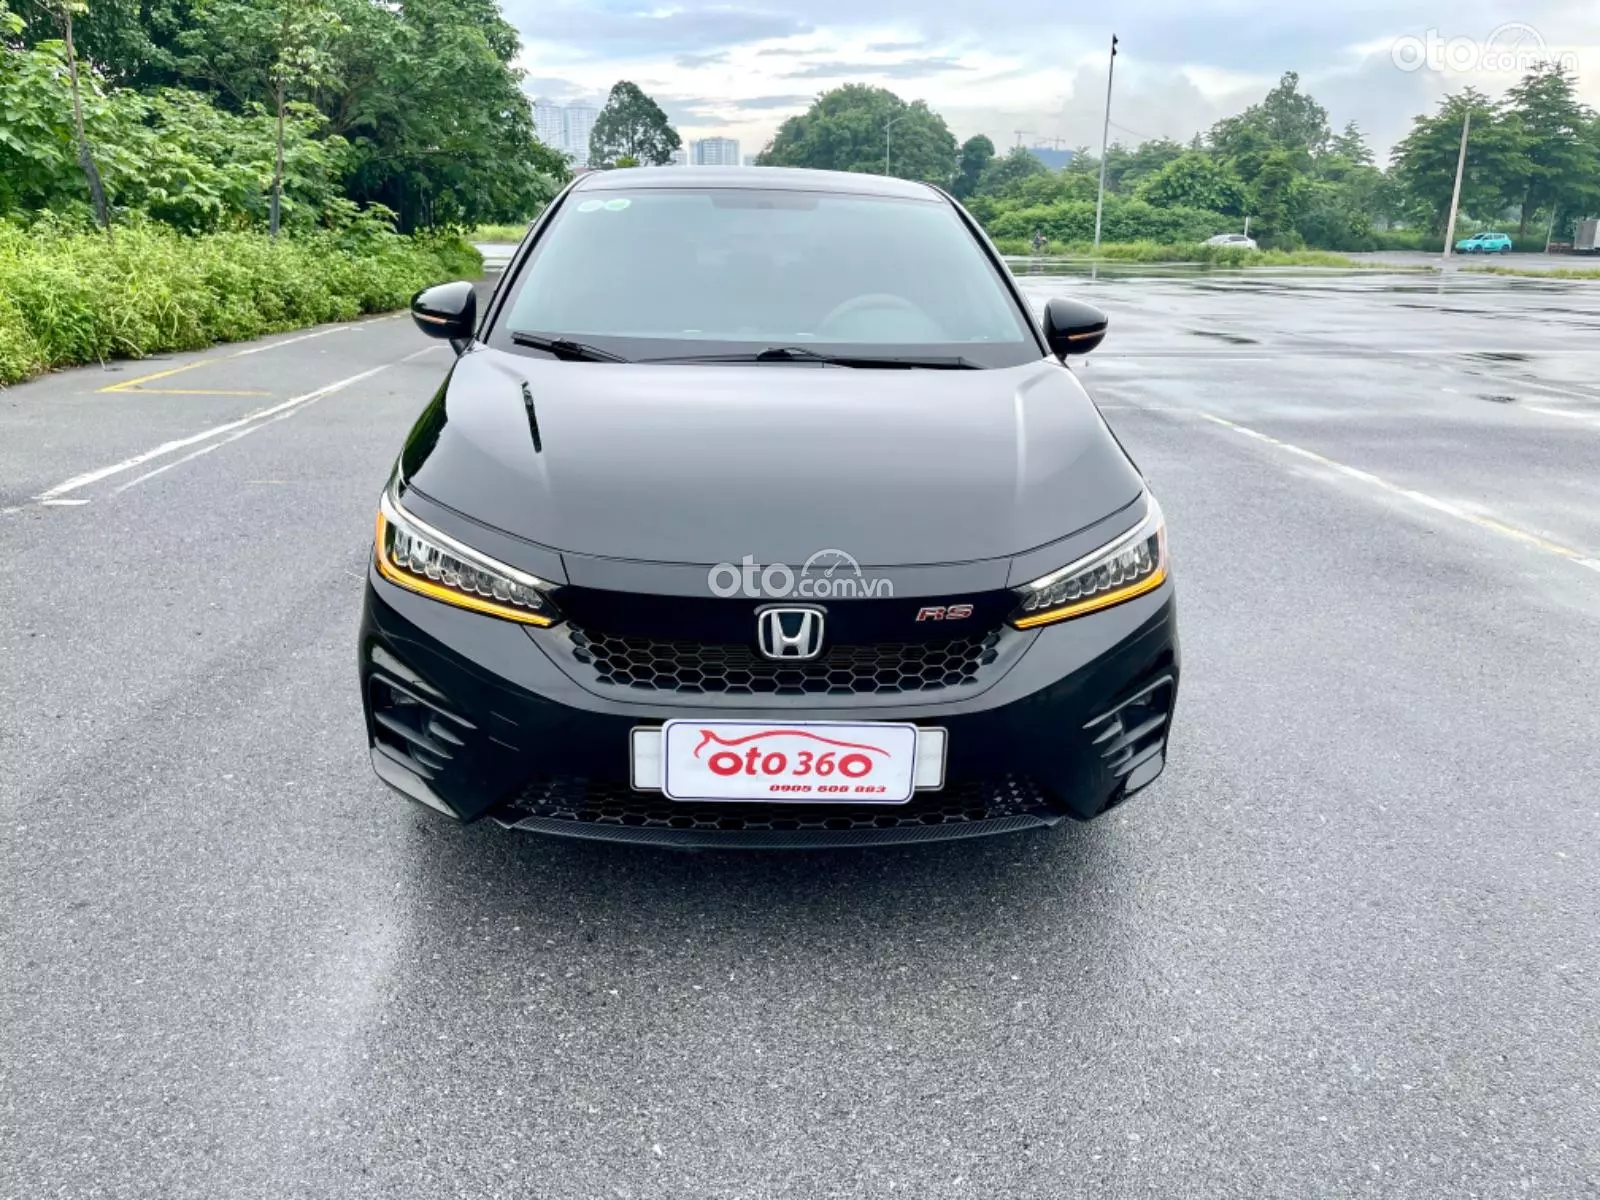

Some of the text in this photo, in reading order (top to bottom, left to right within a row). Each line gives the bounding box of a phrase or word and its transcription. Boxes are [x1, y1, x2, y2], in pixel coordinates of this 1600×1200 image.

[915, 604, 974, 621] RS
[708, 747, 787, 776] oto
[769, 784, 812, 793] 0905
